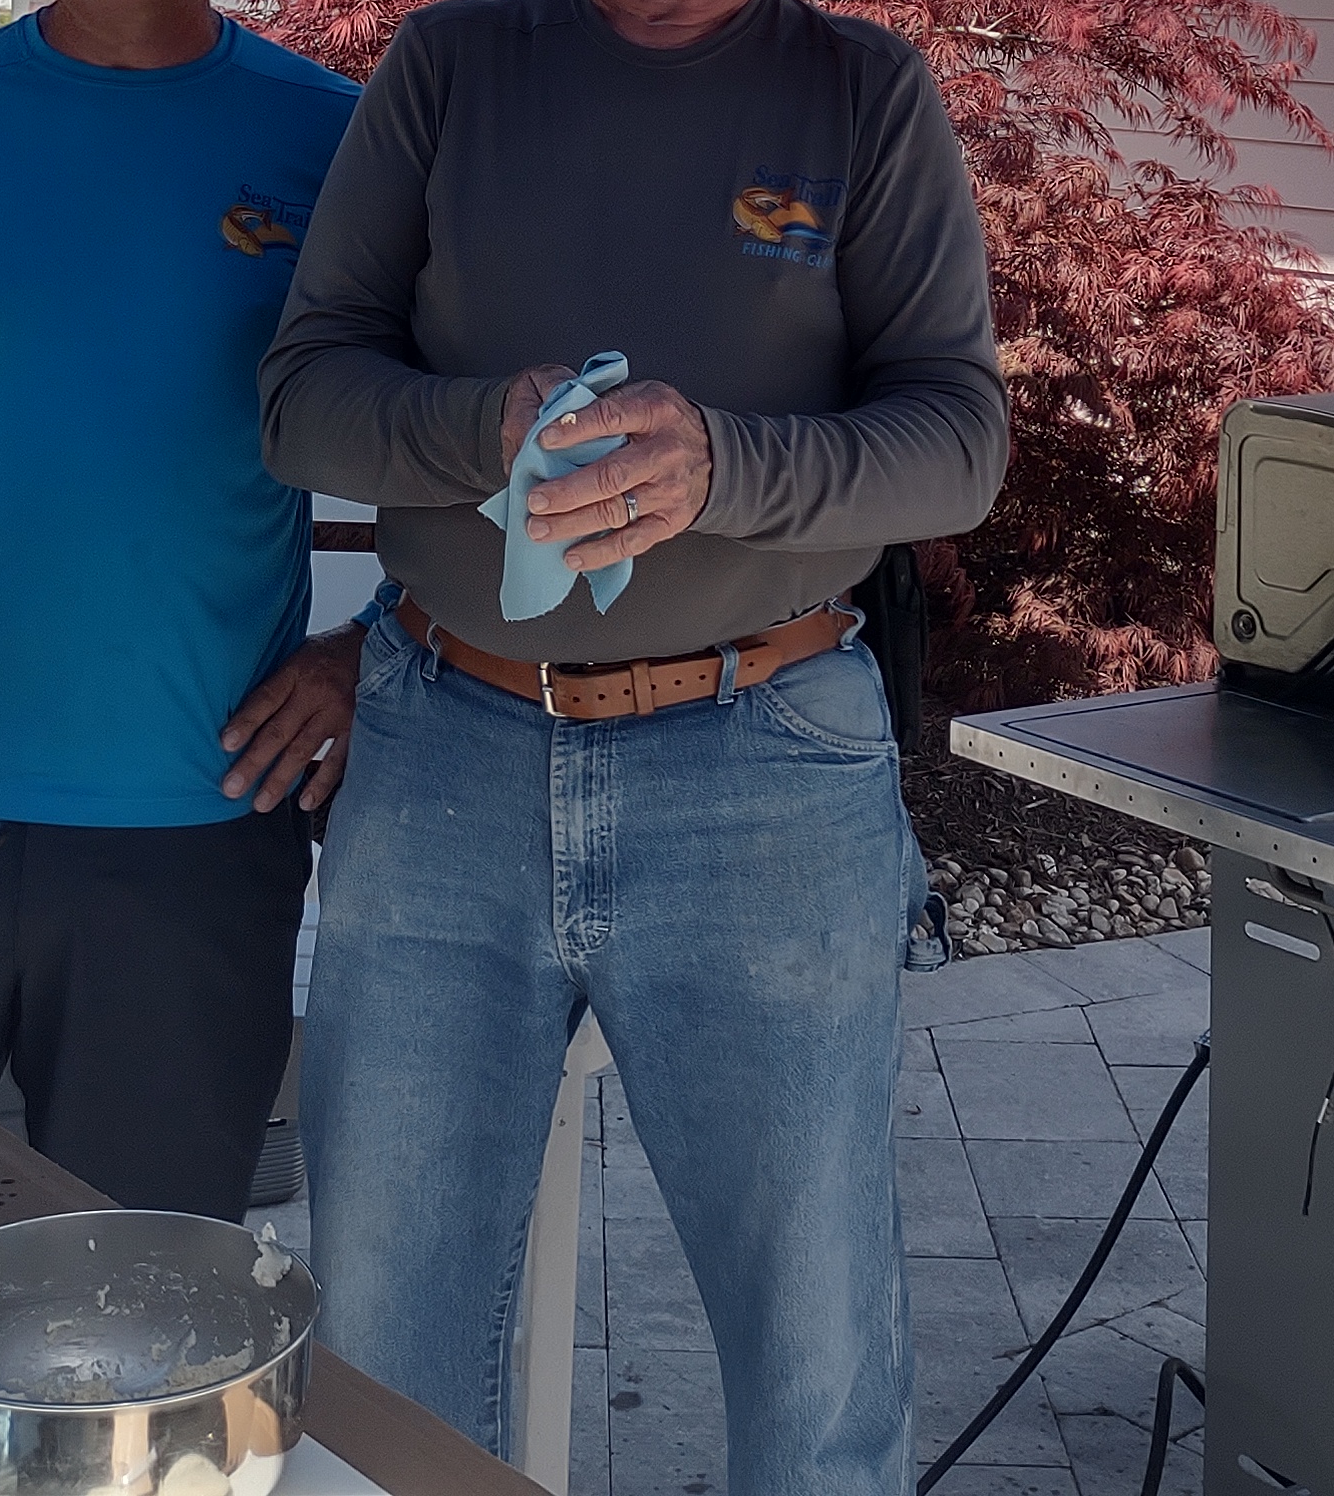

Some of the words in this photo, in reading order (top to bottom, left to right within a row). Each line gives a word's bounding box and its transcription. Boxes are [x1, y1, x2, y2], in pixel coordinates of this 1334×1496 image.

[238, 183, 272, 208] Sea
[272, 196, 314, 228] Trai
[741, 242, 801, 263] FISHING
